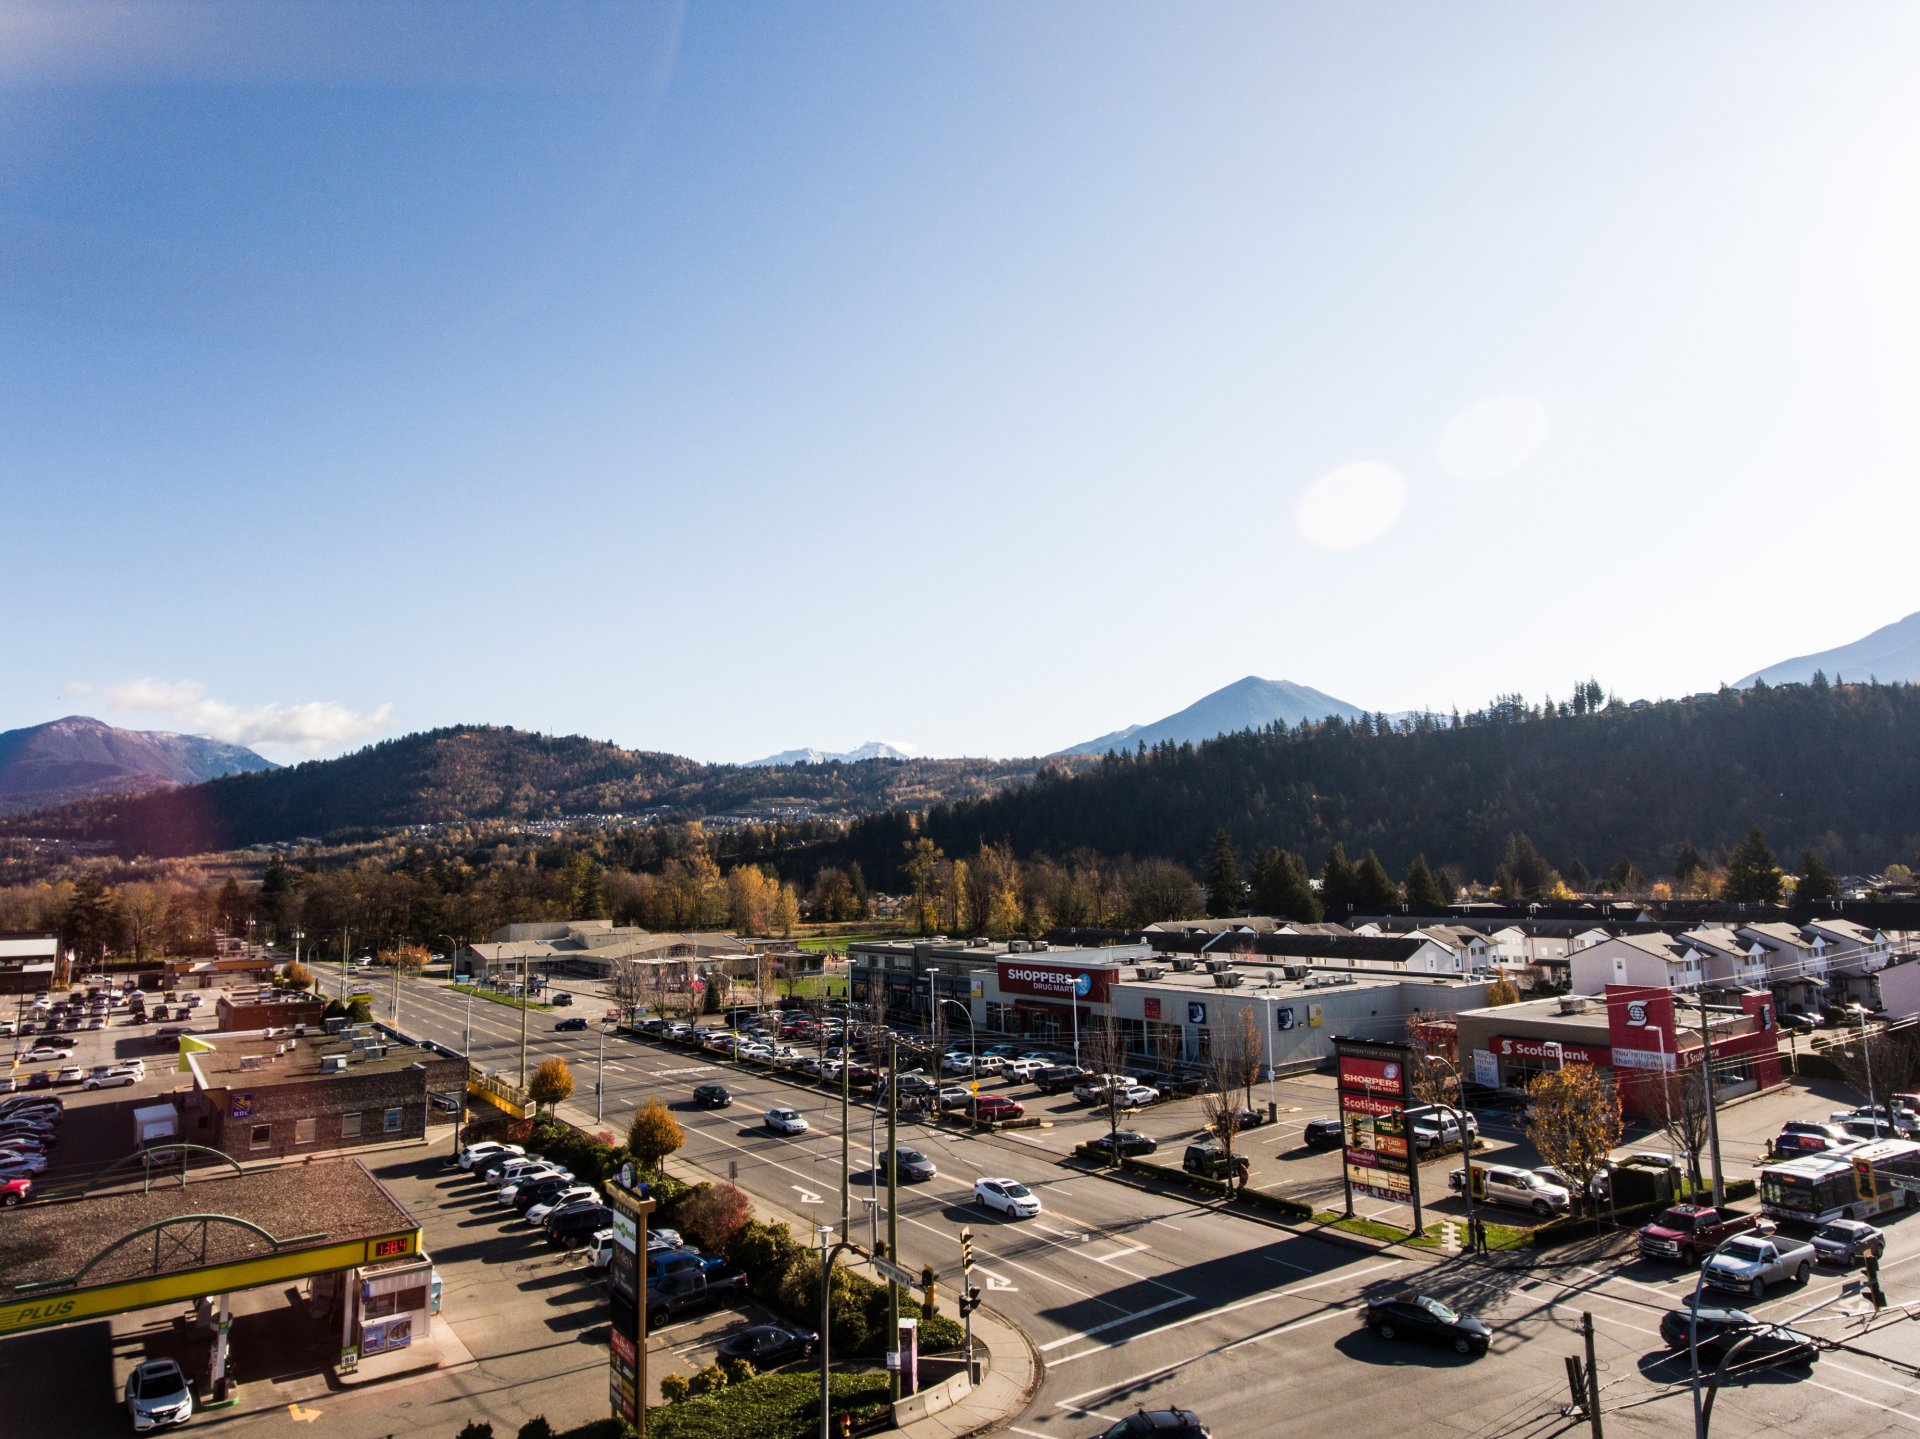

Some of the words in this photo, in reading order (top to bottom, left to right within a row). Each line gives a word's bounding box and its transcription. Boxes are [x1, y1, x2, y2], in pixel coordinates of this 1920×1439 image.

[1008, 968, 1073, 985] SHOPPERS
[1033, 982, 1052, 990] DRUG
[1054, 984, 1074, 992] MART
[1516, 1044, 1589, 1061] Scotiabank
[1344, 1074, 1400, 1088] SHOPPERS
[1352, 1183, 1374, 1194] FOR
[1377, 1188, 1412, 1203] LEASE
[16, 1300, 76, 1322] PLUS
